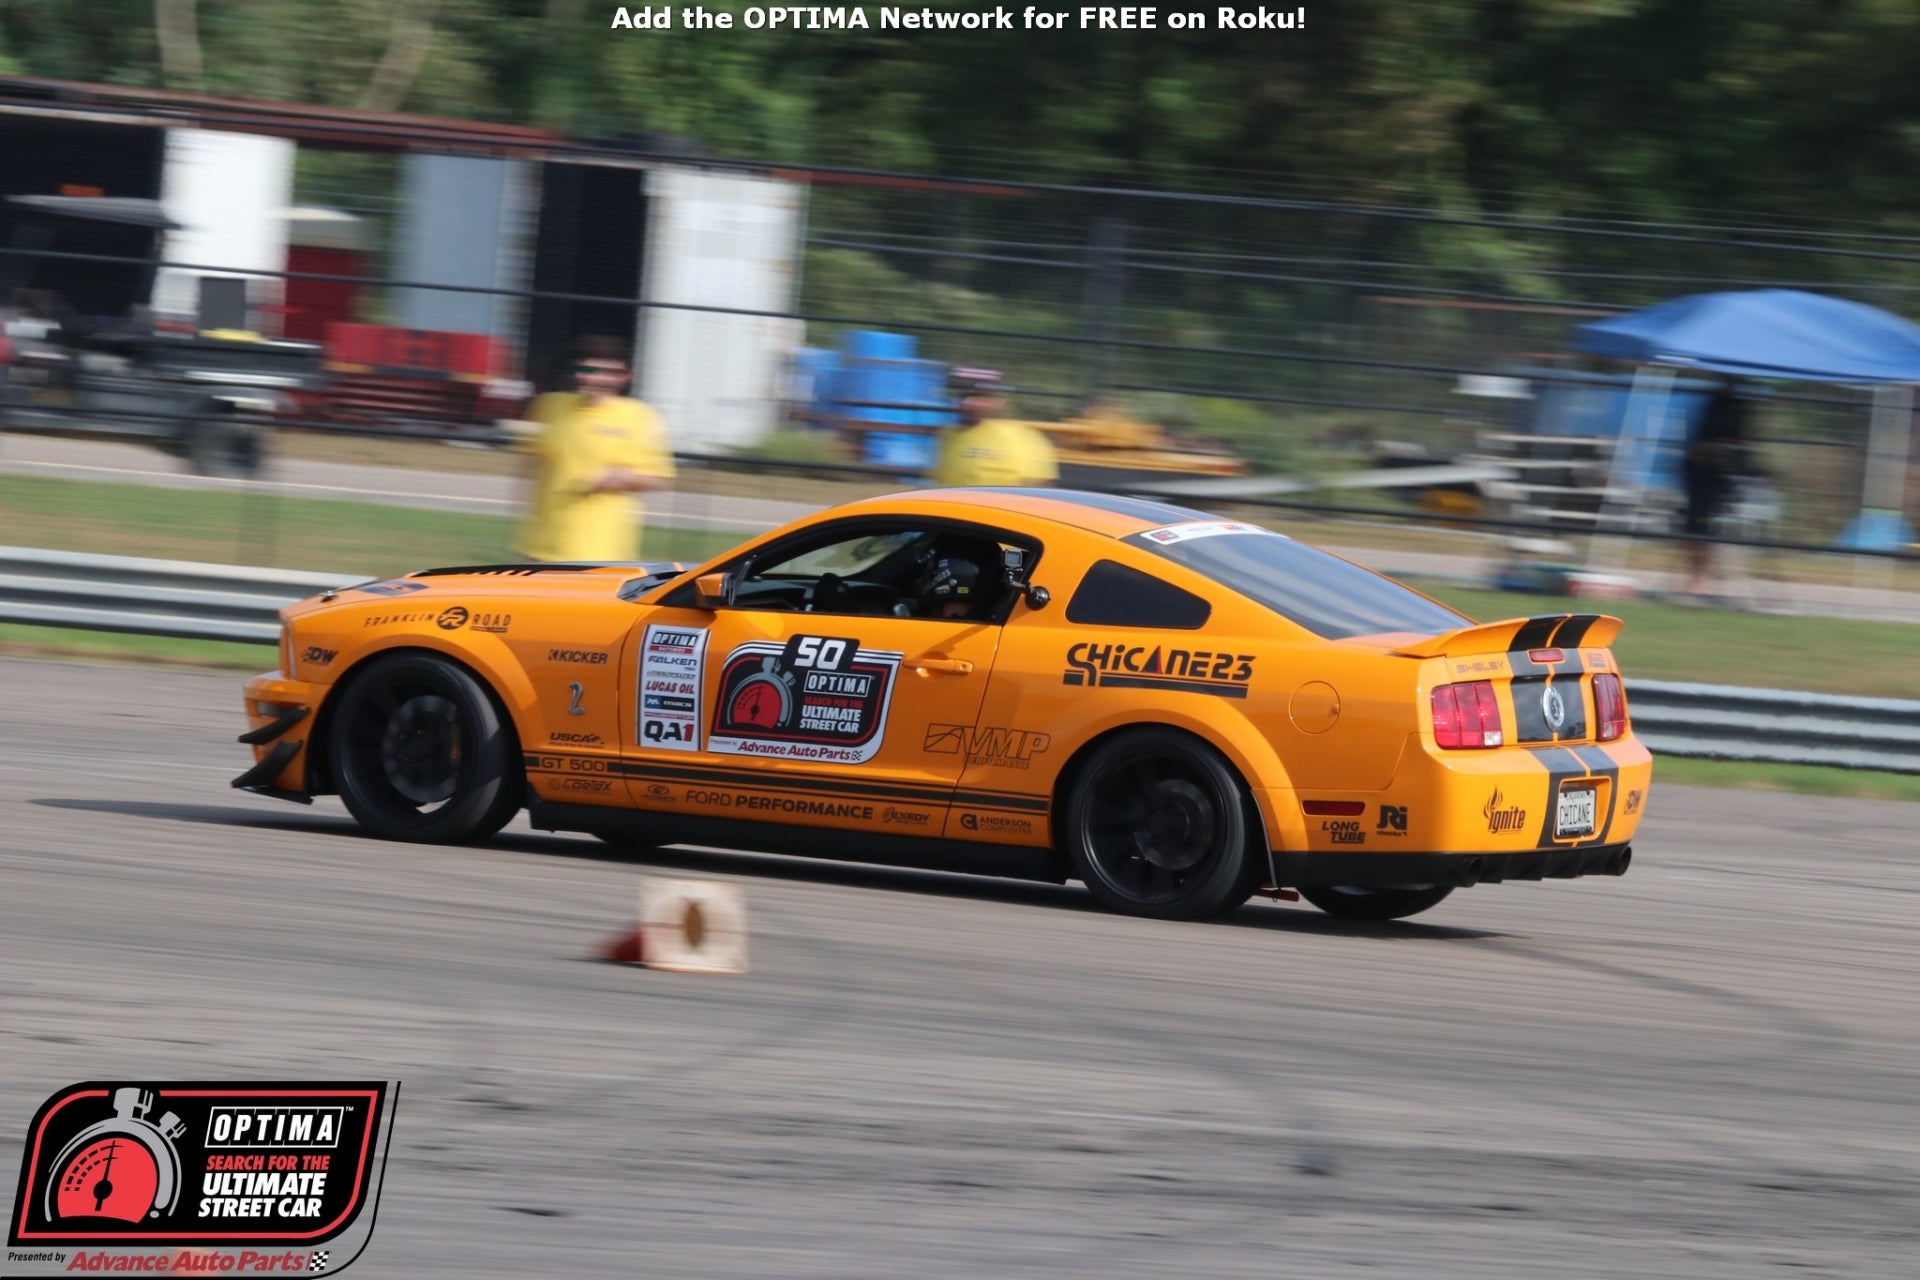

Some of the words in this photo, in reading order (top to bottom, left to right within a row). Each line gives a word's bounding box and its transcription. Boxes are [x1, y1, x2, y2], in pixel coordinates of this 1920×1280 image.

[363, 613, 437, 627] FRANKLIN
[472, 613, 511, 627] ROAD
[652, 633, 697, 646] OPTIMA
[559, 649, 609, 665] KICKER
[794, 636, 847, 670] 50
[648, 655, 697, 667] FALKEN
[1456, 660, 1504, 675] SHELBY
[645, 681, 678, 693] LUCAS
[679, 684, 695, 694] OIL
[807, 674, 868, 694] OPTIMA
[801, 705, 862, 722] ULTIMATE
[644, 720, 695, 743] QA1
[800, 719, 837, 731] STREET
[837, 721, 860, 733] CAR
[738, 740, 786, 755] Advance
[787, 745, 819, 757] Auto
[818, 747, 851, 761] Parts
[961, 726, 1051, 760] VMP
[541, 757, 564, 769] GT
[569, 760, 606, 772] 500
[686, 790, 732, 807] FORD
[735, 795, 874, 820] PERFORMANCE
[1488, 806, 1526, 834] ignite
[1559, 803, 1592, 826] CHICANE
[980, 817, 1031, 828] ANDERSON
[1321, 821, 1360, 832] LONG
[1331, 832, 1366, 844] TUBE
